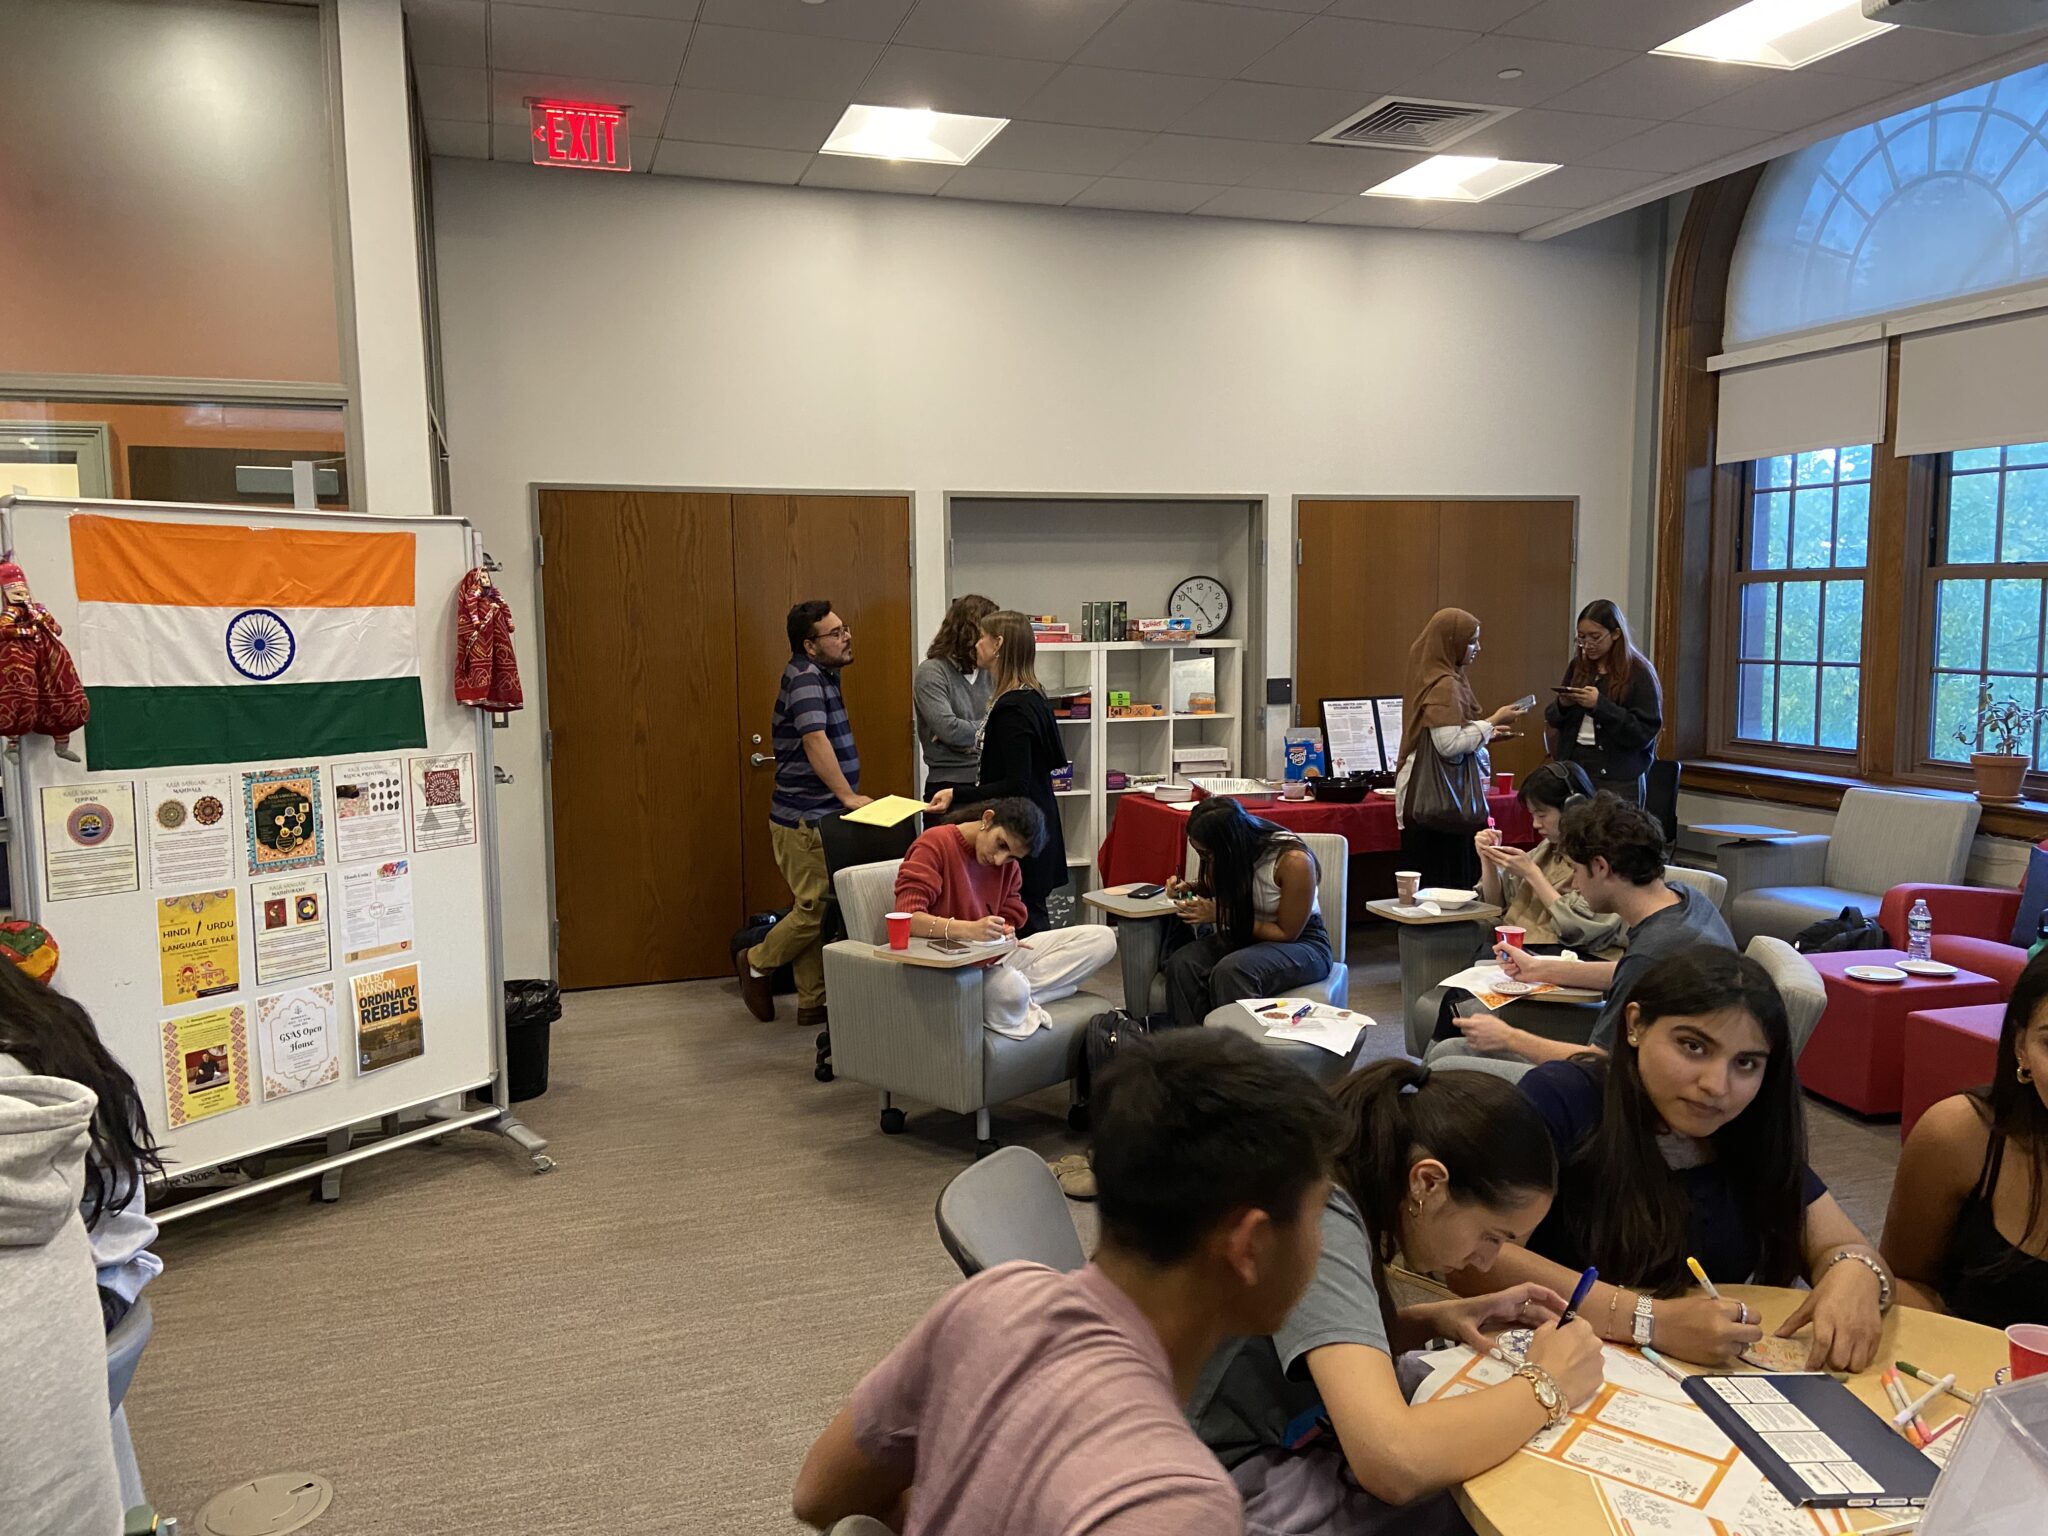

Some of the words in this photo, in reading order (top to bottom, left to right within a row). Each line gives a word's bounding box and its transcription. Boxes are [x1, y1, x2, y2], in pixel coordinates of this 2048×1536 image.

[546, 109, 619, 164] EXIT
[1215, 592, 1220, 600] 2
[1217, 602, 1223, 610] 3
[1196, 623, 1202, 631] 6
[163, 927, 191, 939] HINDI
[206, 920, 234, 932] URDU
[162, 938, 208, 953] LANGUAGE
[211, 934, 235, 945] TABLE
[359, 978, 396, 997] HANSON
[359, 985, 416, 1009] ORDINARY
[361, 996, 418, 1025] REBELS
[279, 1029, 302, 1043] GSAS
[302, 1025, 322, 1037] Open
[289, 1039, 315, 1053] House
[182, 1170, 216, 1185] Shops
